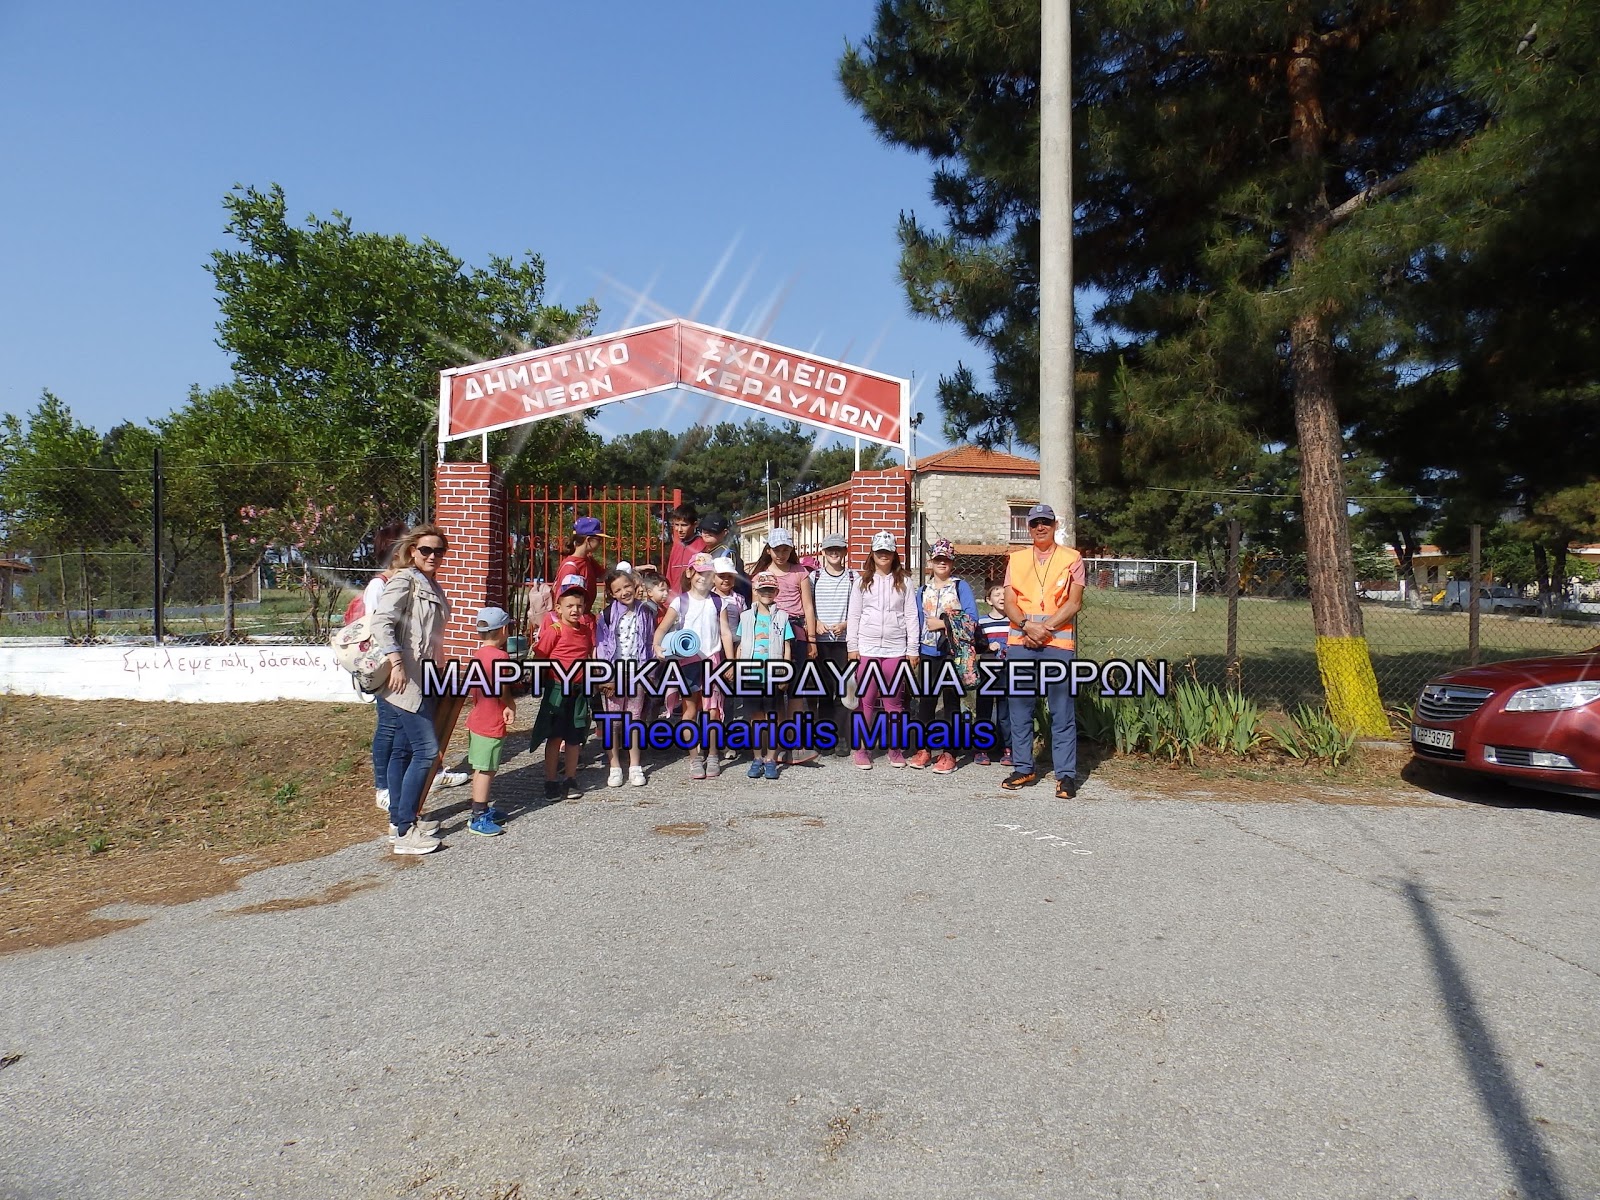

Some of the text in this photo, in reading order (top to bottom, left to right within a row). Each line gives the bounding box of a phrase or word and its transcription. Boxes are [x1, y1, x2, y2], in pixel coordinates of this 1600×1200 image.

[465, 338, 847, 401] ΔΗΜΟΤΙΚΟ ΣΧΟΛΕΙΟ
[521, 364, 884, 432] ΝΕΩΝ ΚΕΡΔΥΛΙΩΝ
[122, 648, 211, 681] Σμίλεψε
[258, 649, 327, 671] δάσκαλε,
